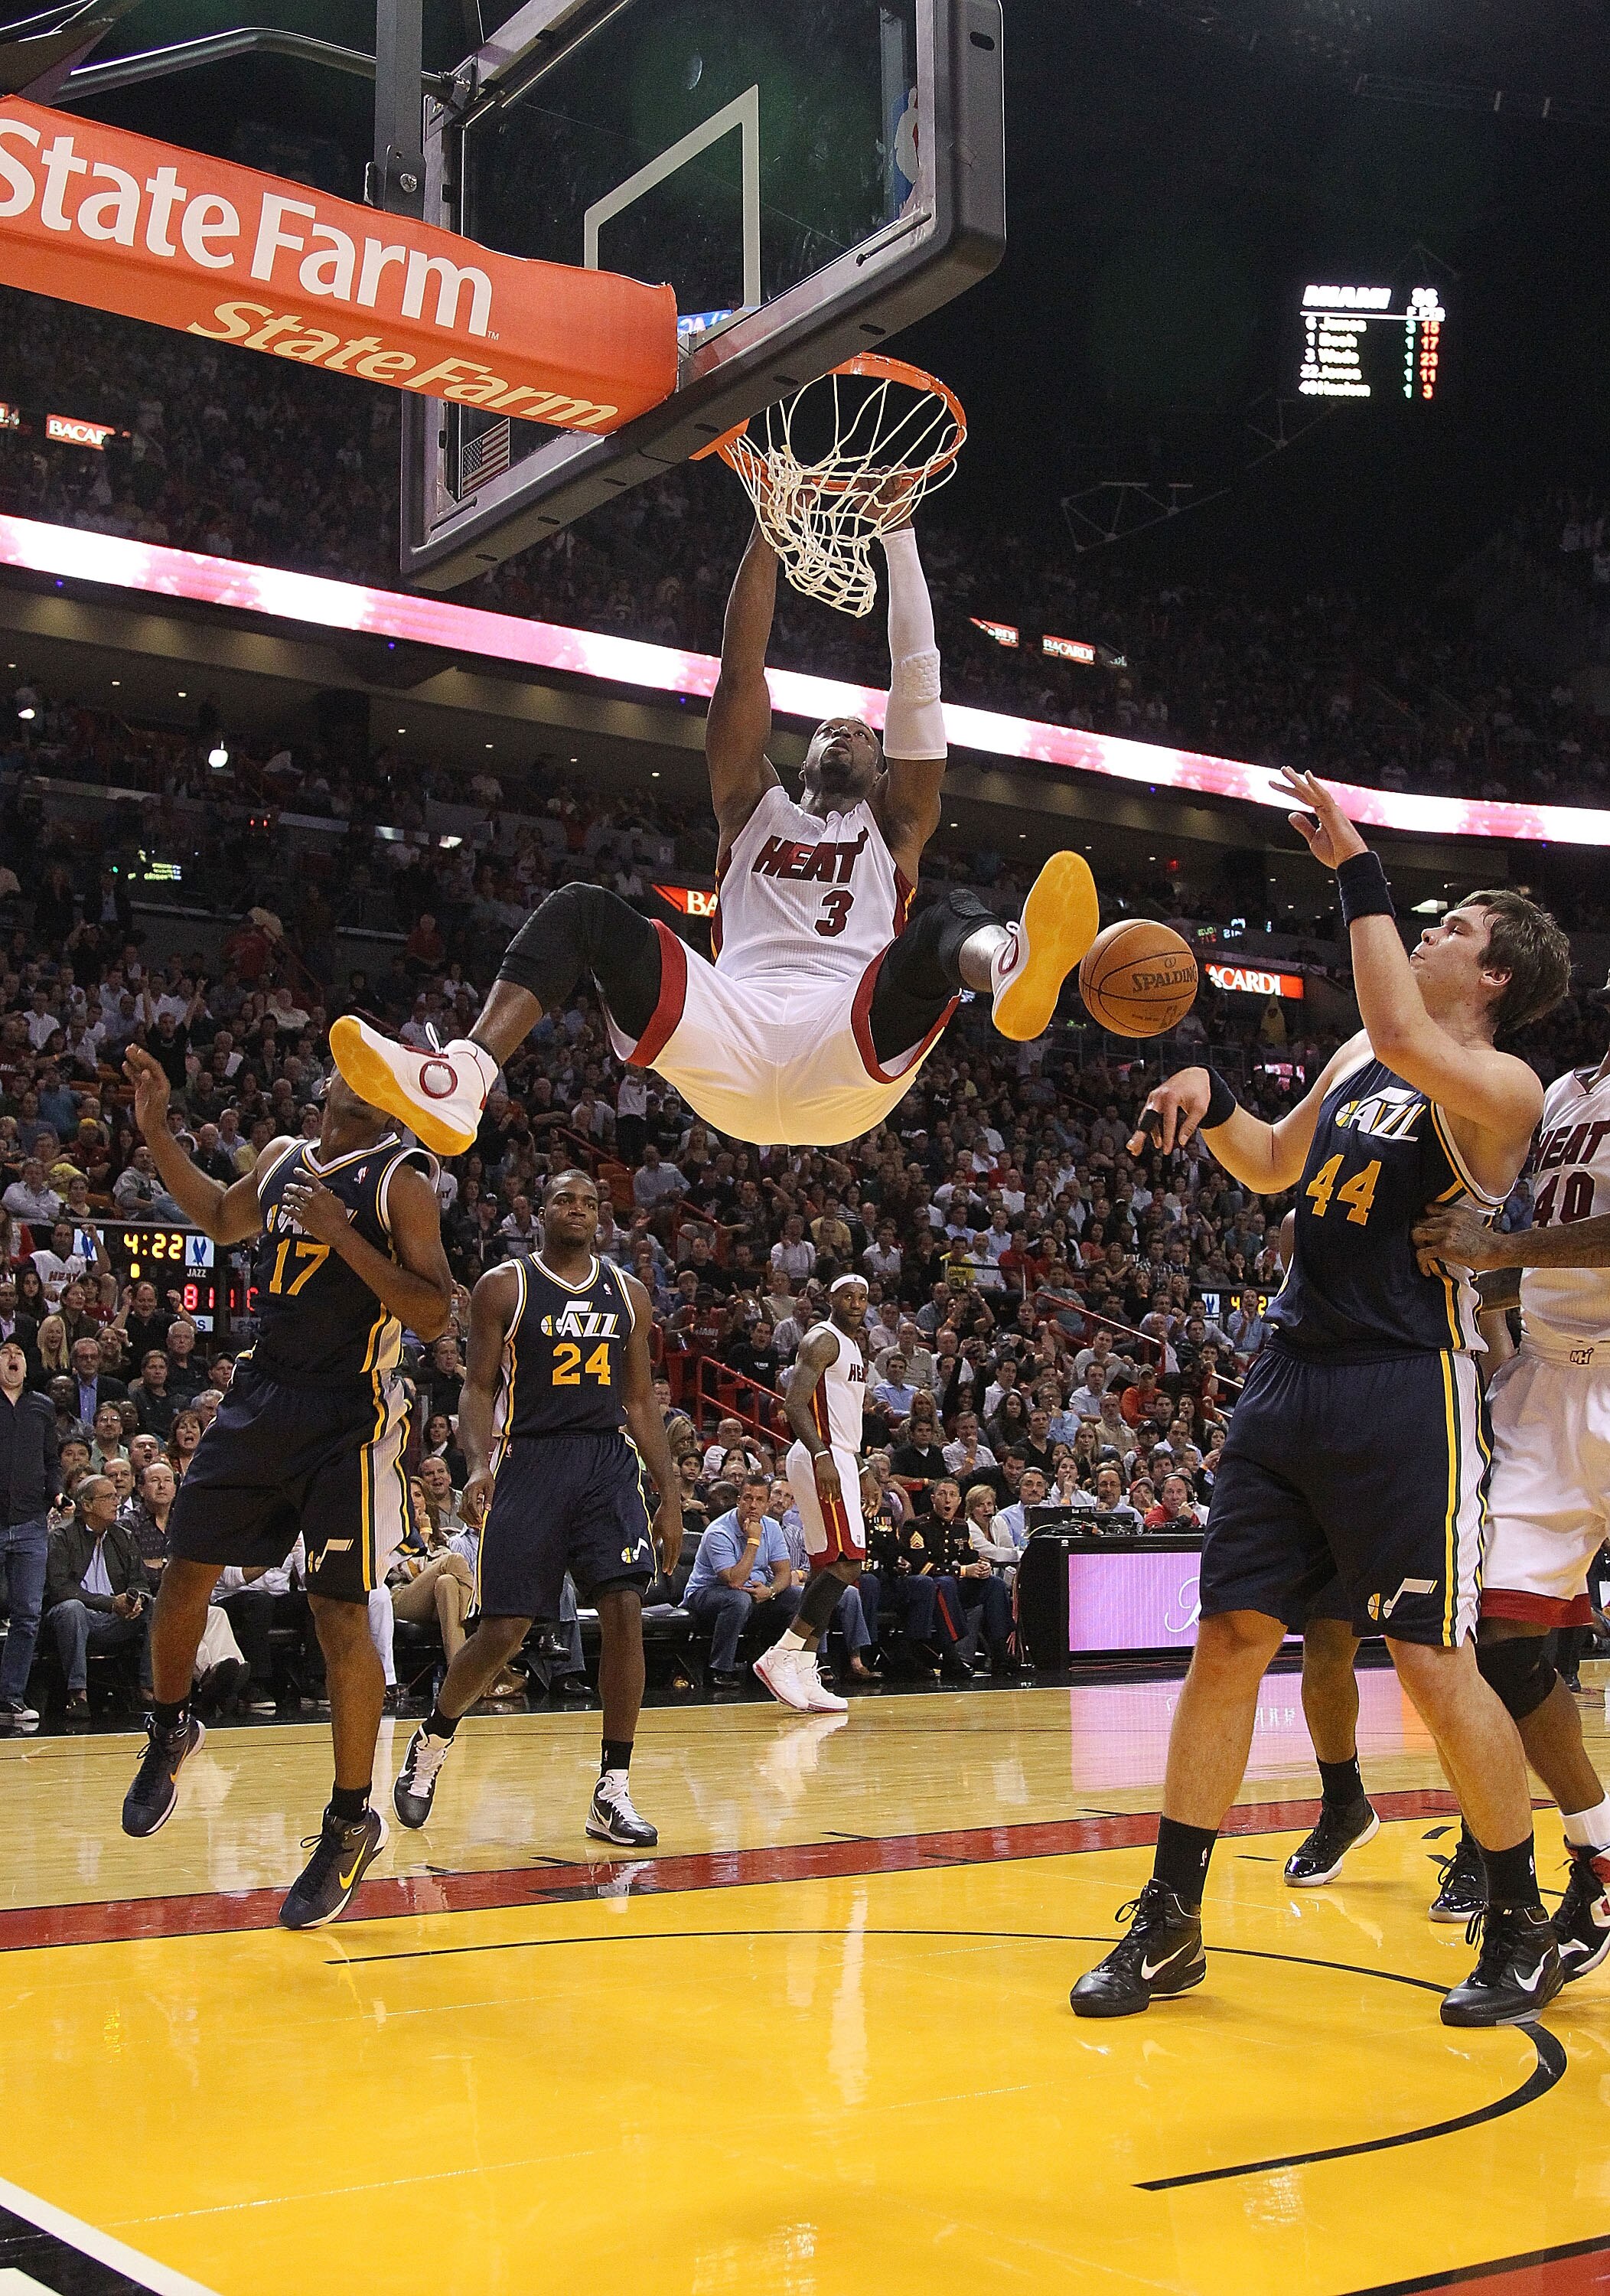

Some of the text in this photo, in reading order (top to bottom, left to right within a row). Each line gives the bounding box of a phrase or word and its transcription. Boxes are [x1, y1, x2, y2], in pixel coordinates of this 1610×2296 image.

[0, 119, 240, 269] State
[250, 191, 493, 338] Farm
[1305, 331, 1315, 346] 1
[1405, 336, 1414, 350] 1
[1421, 336, 1439, 351] 17
[1406, 320, 1416, 334] 3
[1421, 321, 1440, 334] 15
[186, 302, 618, 428] State Farm
[1305, 347, 1316, 363] 3
[1404, 352, 1413, 366] 1
[1420, 351, 1439, 367] 23
[1403, 368, 1413, 382] 1
[1419, 368, 1436, 383] 11
[1403, 383, 1412, 398] 1
[1423, 384, 1433, 400] 3
[751, 826, 869, 883] HEAT
[813, 889, 855, 938] 3
[1305, 1154, 1381, 1225] 44
[1533, 1172, 1595, 1228] 40
[124, 1233, 184, 1259] 4:22
[187, 1269, 207, 1277] JAZZ
[269, 1238, 330, 1296] 17
[184, 1283, 214, 1310] 81
[541, 1300, 621, 1339] JAZZ
[552, 1342, 611, 1385] 24
